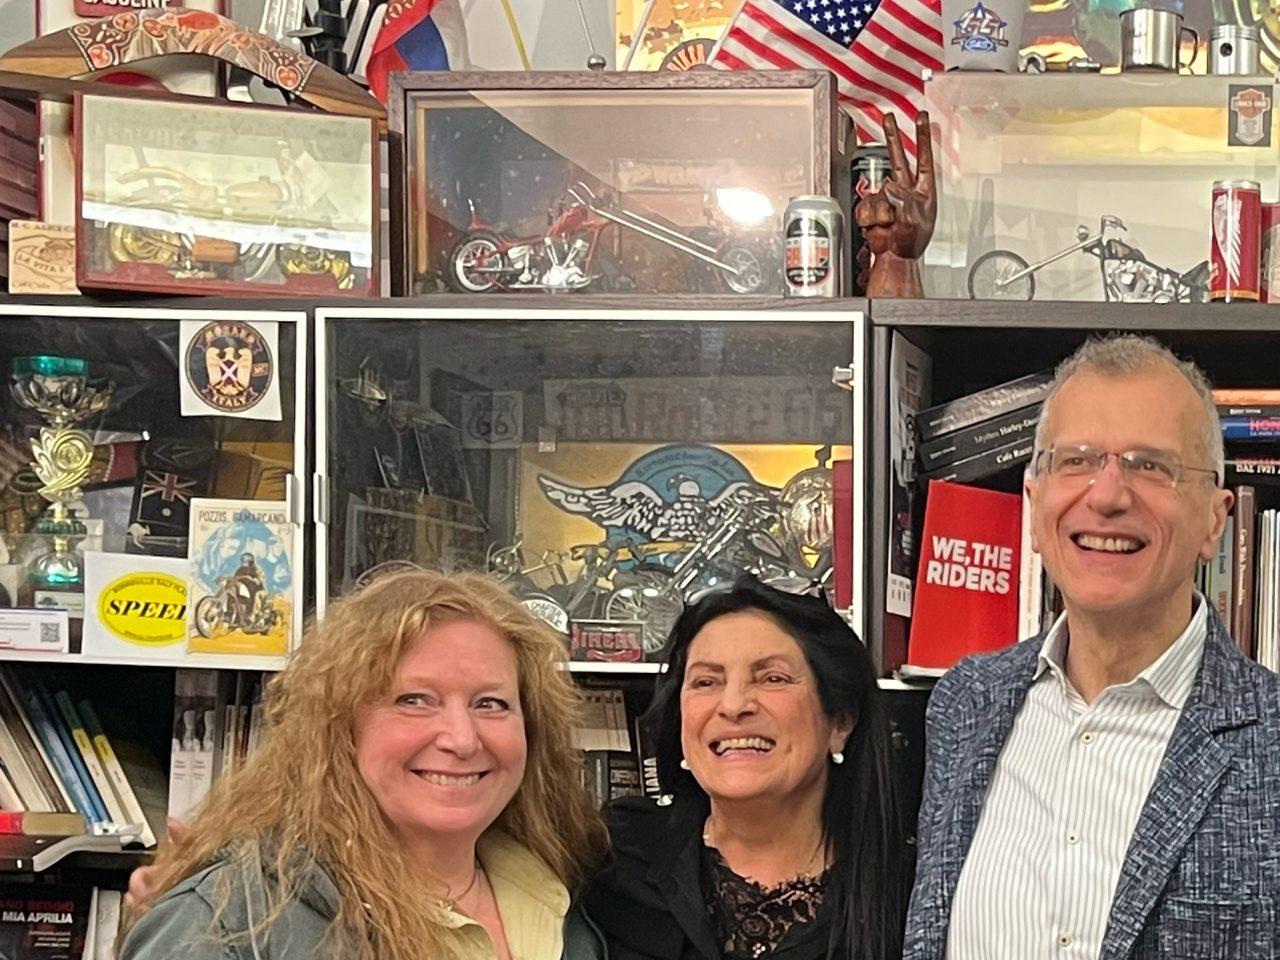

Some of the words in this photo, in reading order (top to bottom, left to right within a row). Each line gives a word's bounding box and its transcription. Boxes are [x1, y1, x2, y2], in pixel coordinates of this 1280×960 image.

[1236, 464, 1255, 473] DAL
[1257, 464, 1276, 474] 1921
[199, 510, 228, 522] POZZIS
[233, 510, 287, 524] SAMARCAND
[926, 560, 1010, 594] RIDERS
[2, 911, 25, 922] MIA
[27, 911, 73, 924] APRILIA
